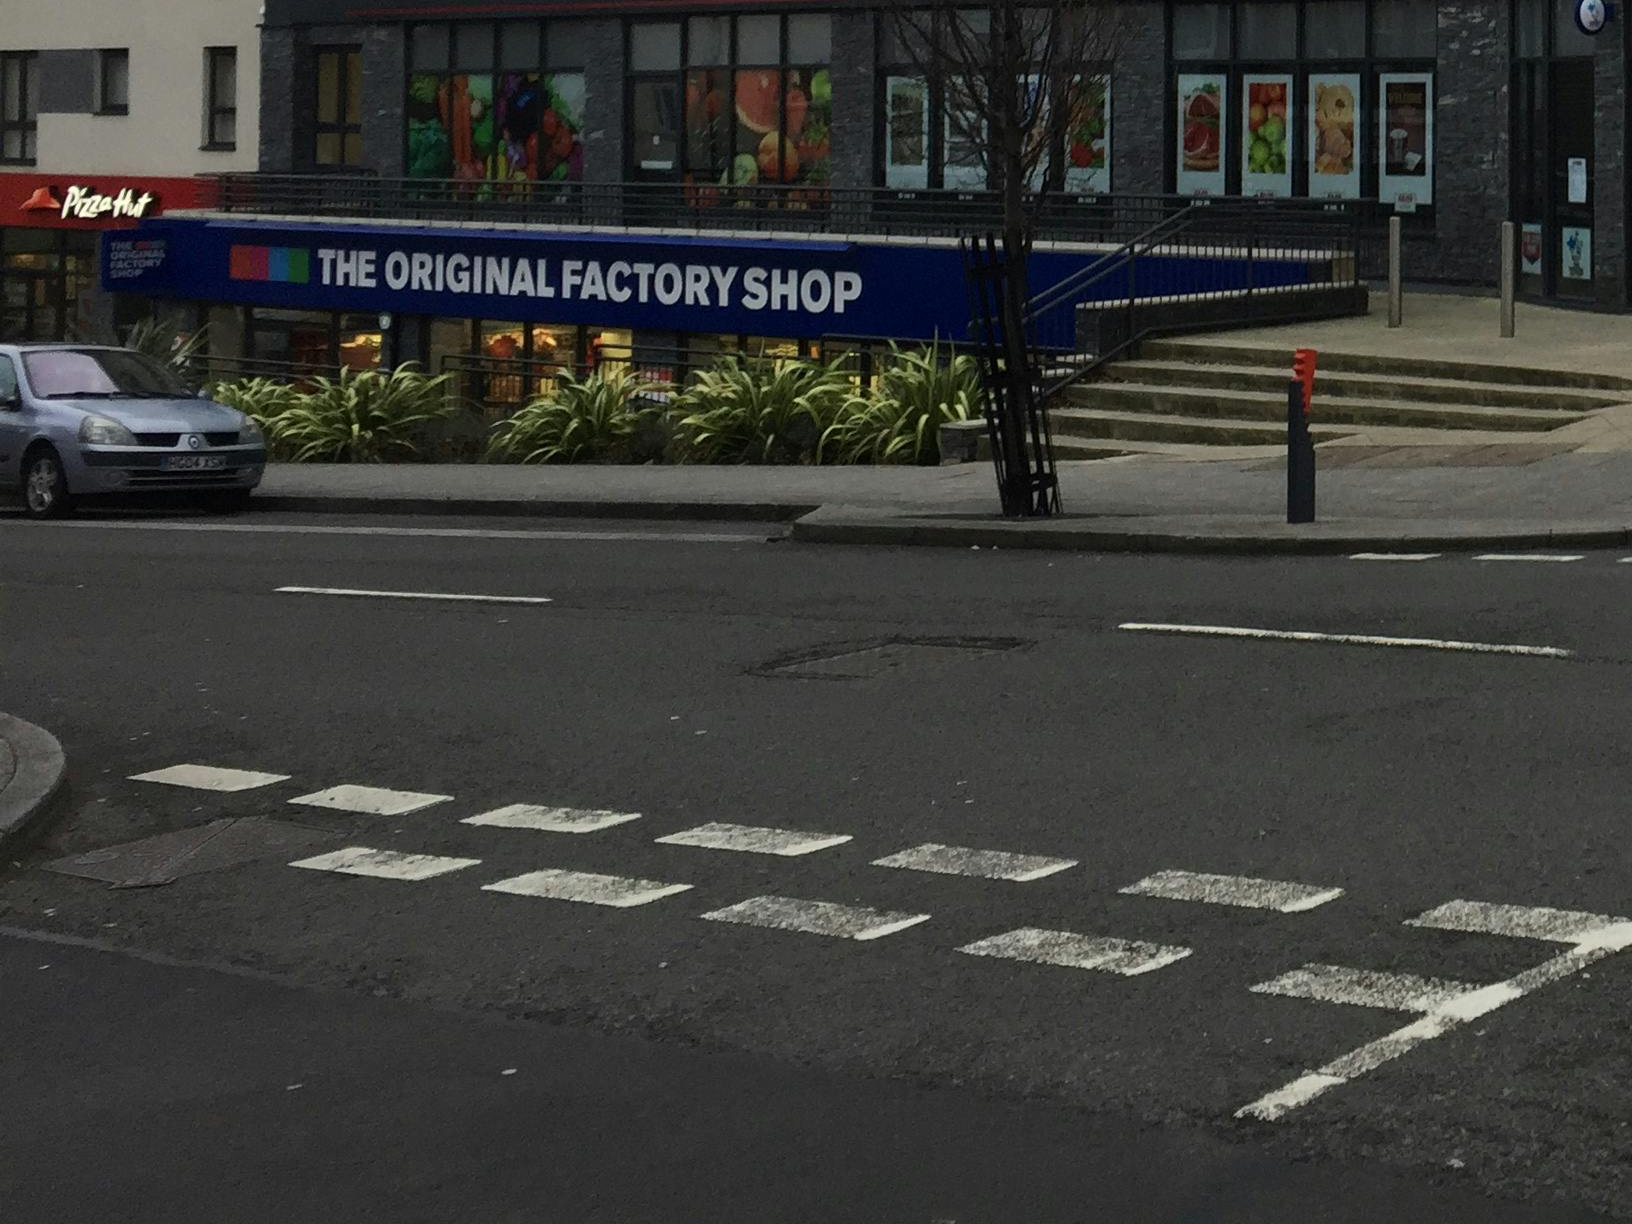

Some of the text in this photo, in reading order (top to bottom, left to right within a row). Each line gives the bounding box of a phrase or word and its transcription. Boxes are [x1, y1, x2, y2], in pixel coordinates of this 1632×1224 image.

[61, 185, 153, 220] Pizza Hut
[110, 241, 133, 251] THE
[110, 249, 166, 260] ORIGINAL
[110, 259, 163, 269] FACTORY
[110, 268, 145, 279] SHOP
[317, 248, 863, 314] THE ORIGINAL FACTORY SHOP
